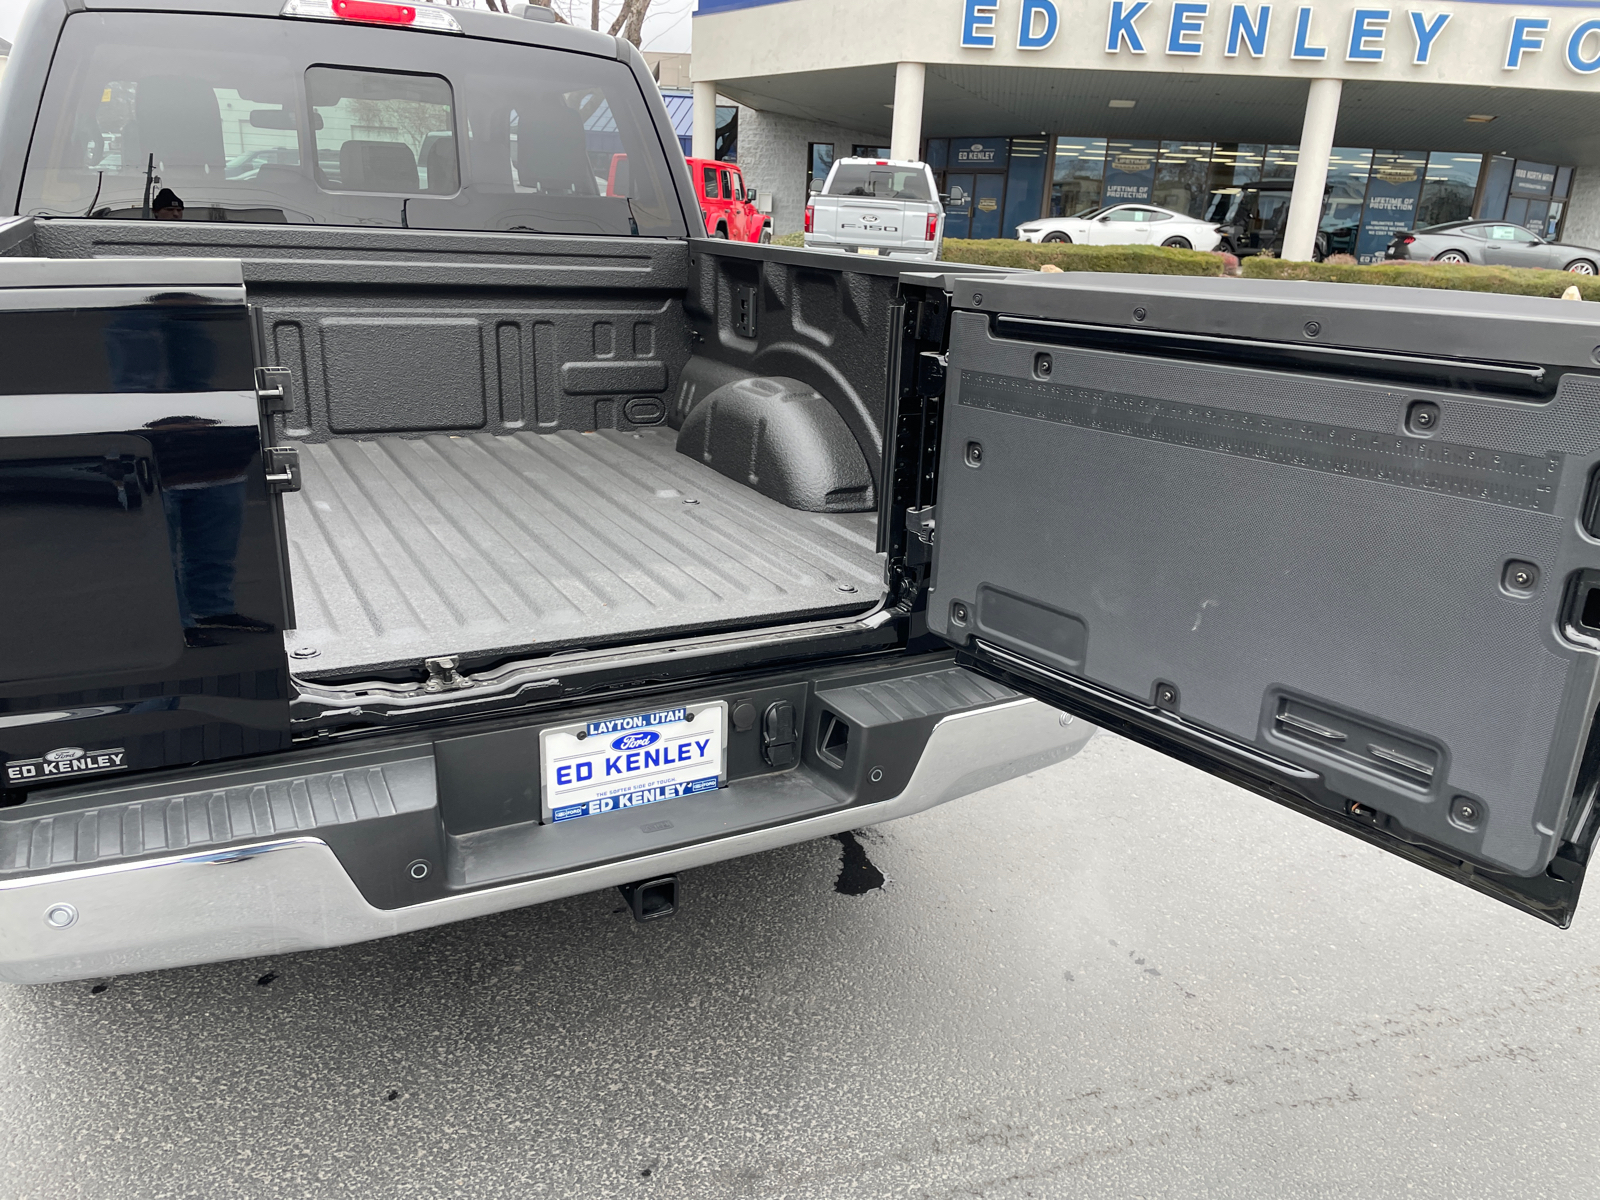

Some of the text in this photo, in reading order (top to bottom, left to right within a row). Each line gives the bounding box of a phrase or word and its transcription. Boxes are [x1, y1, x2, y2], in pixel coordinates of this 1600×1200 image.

[960, 0, 1600, 75] ED KENLEY FO
[841, 223, 898, 232] F-150
[590, 709, 684, 734] LAYTON, UTAH
[620, 734, 650, 750] Ford
[8, 754, 124, 779] ED KENLEY
[556, 738, 710, 786] ED KENLEY
[589, 782, 687, 814] ED KENLEY
